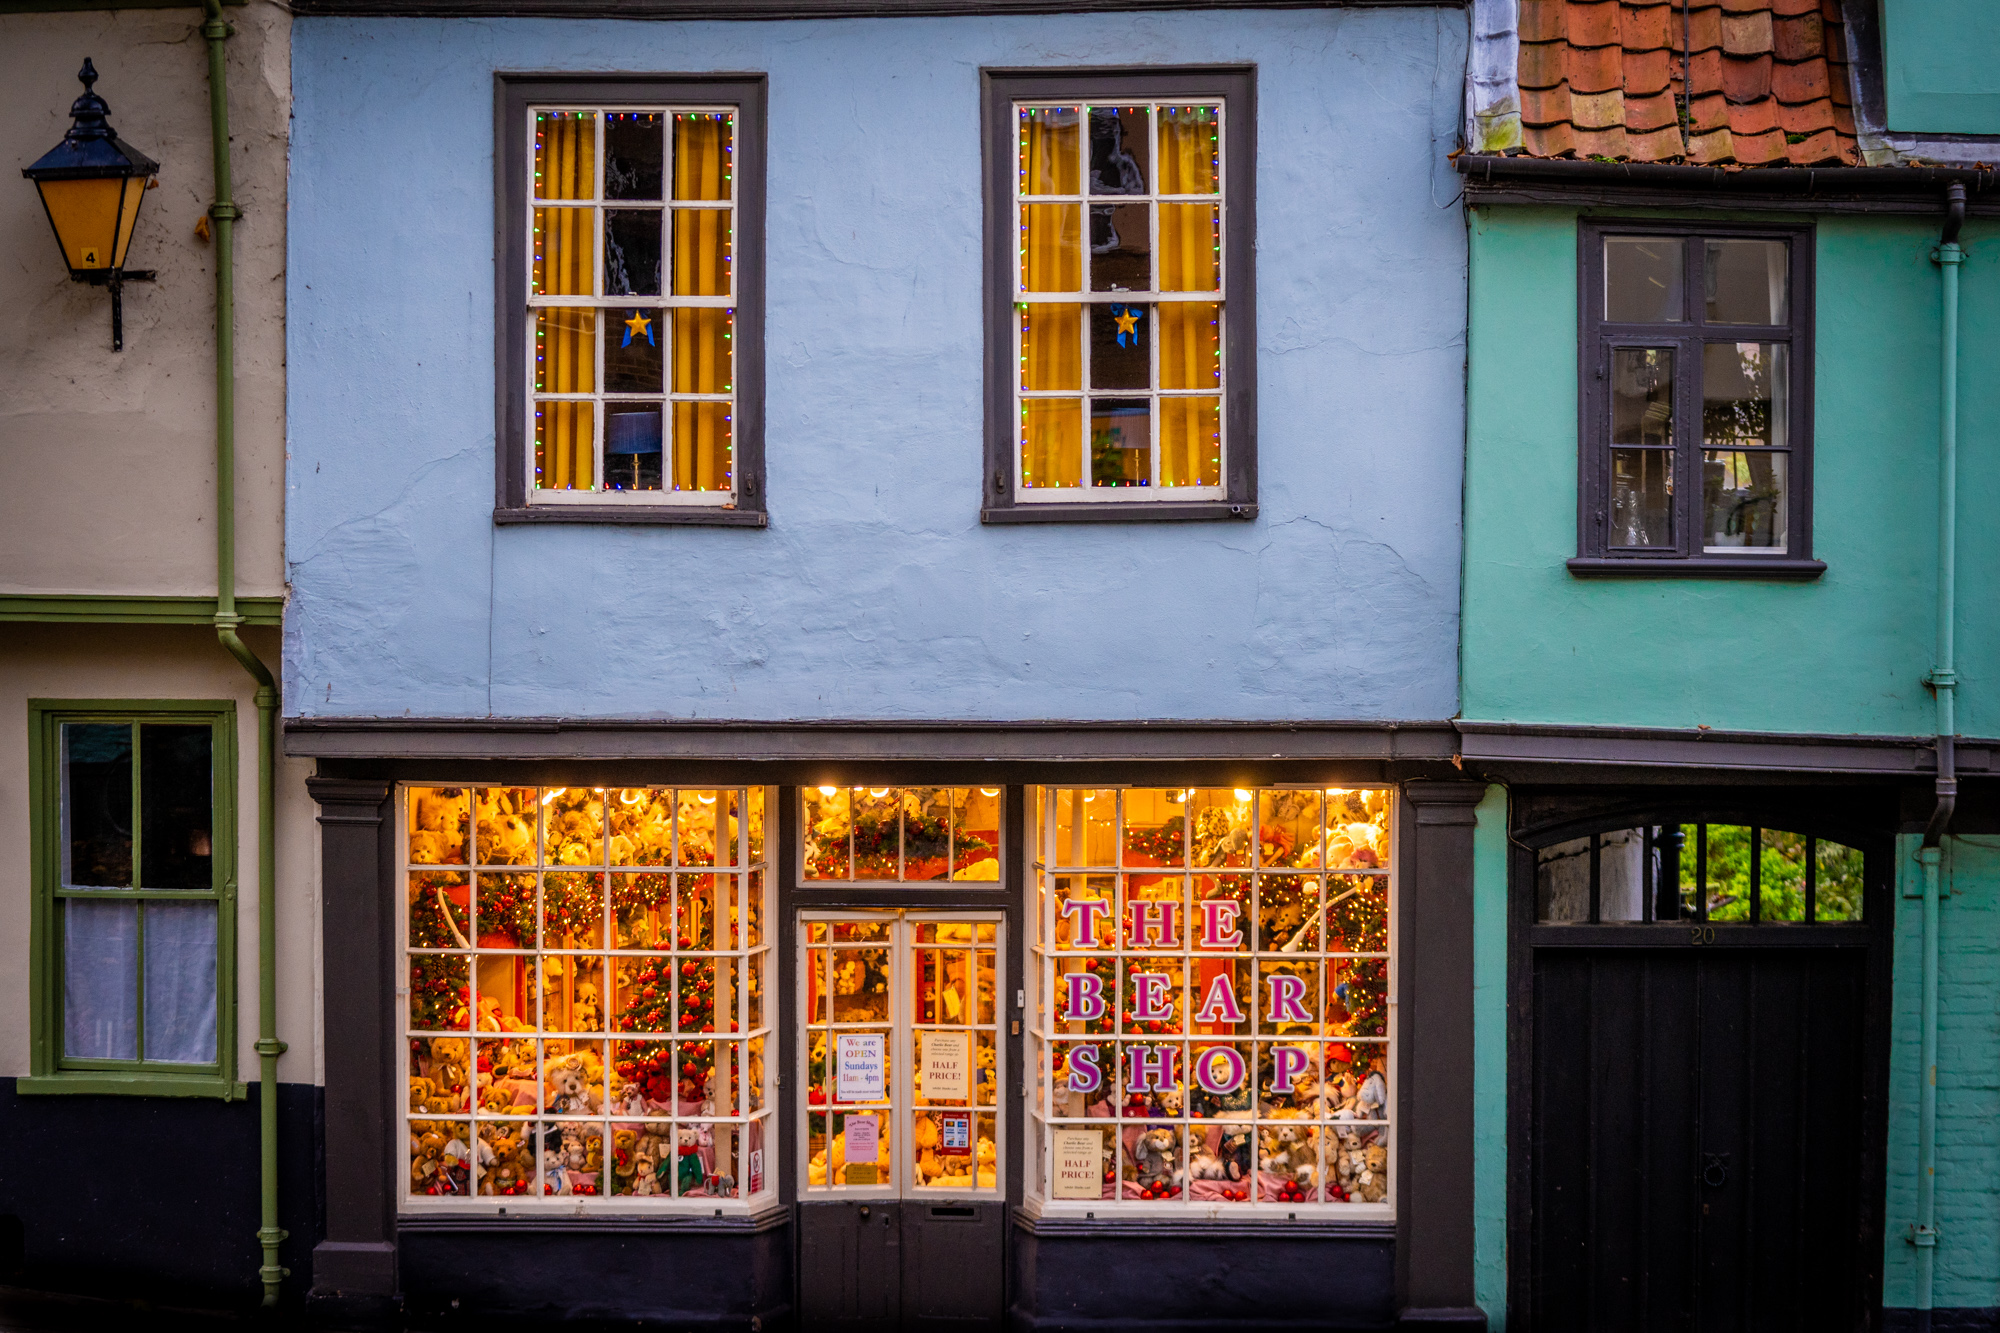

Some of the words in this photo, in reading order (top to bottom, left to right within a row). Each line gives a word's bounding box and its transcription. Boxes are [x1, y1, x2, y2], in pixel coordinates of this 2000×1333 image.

[86, 252, 96, 264] 4
[1061, 898, 1244, 948] THE
[1691, 926, 1715, 945] 20
[1063, 973, 1313, 1023] BEAR
[845, 1050, 876, 1058] OPEN
[844, 1061, 878, 1072] Sundays
[932, 1061, 958, 1069] HALF
[1068, 1044, 1310, 1094] SHOP
[843, 1073, 859, 1082] 11am
[865, 1073, 879, 1084] 4pm
[929, 1072, 961, 1080] PRICE!
[1061, 1171, 1094, 1179] PRICE!
